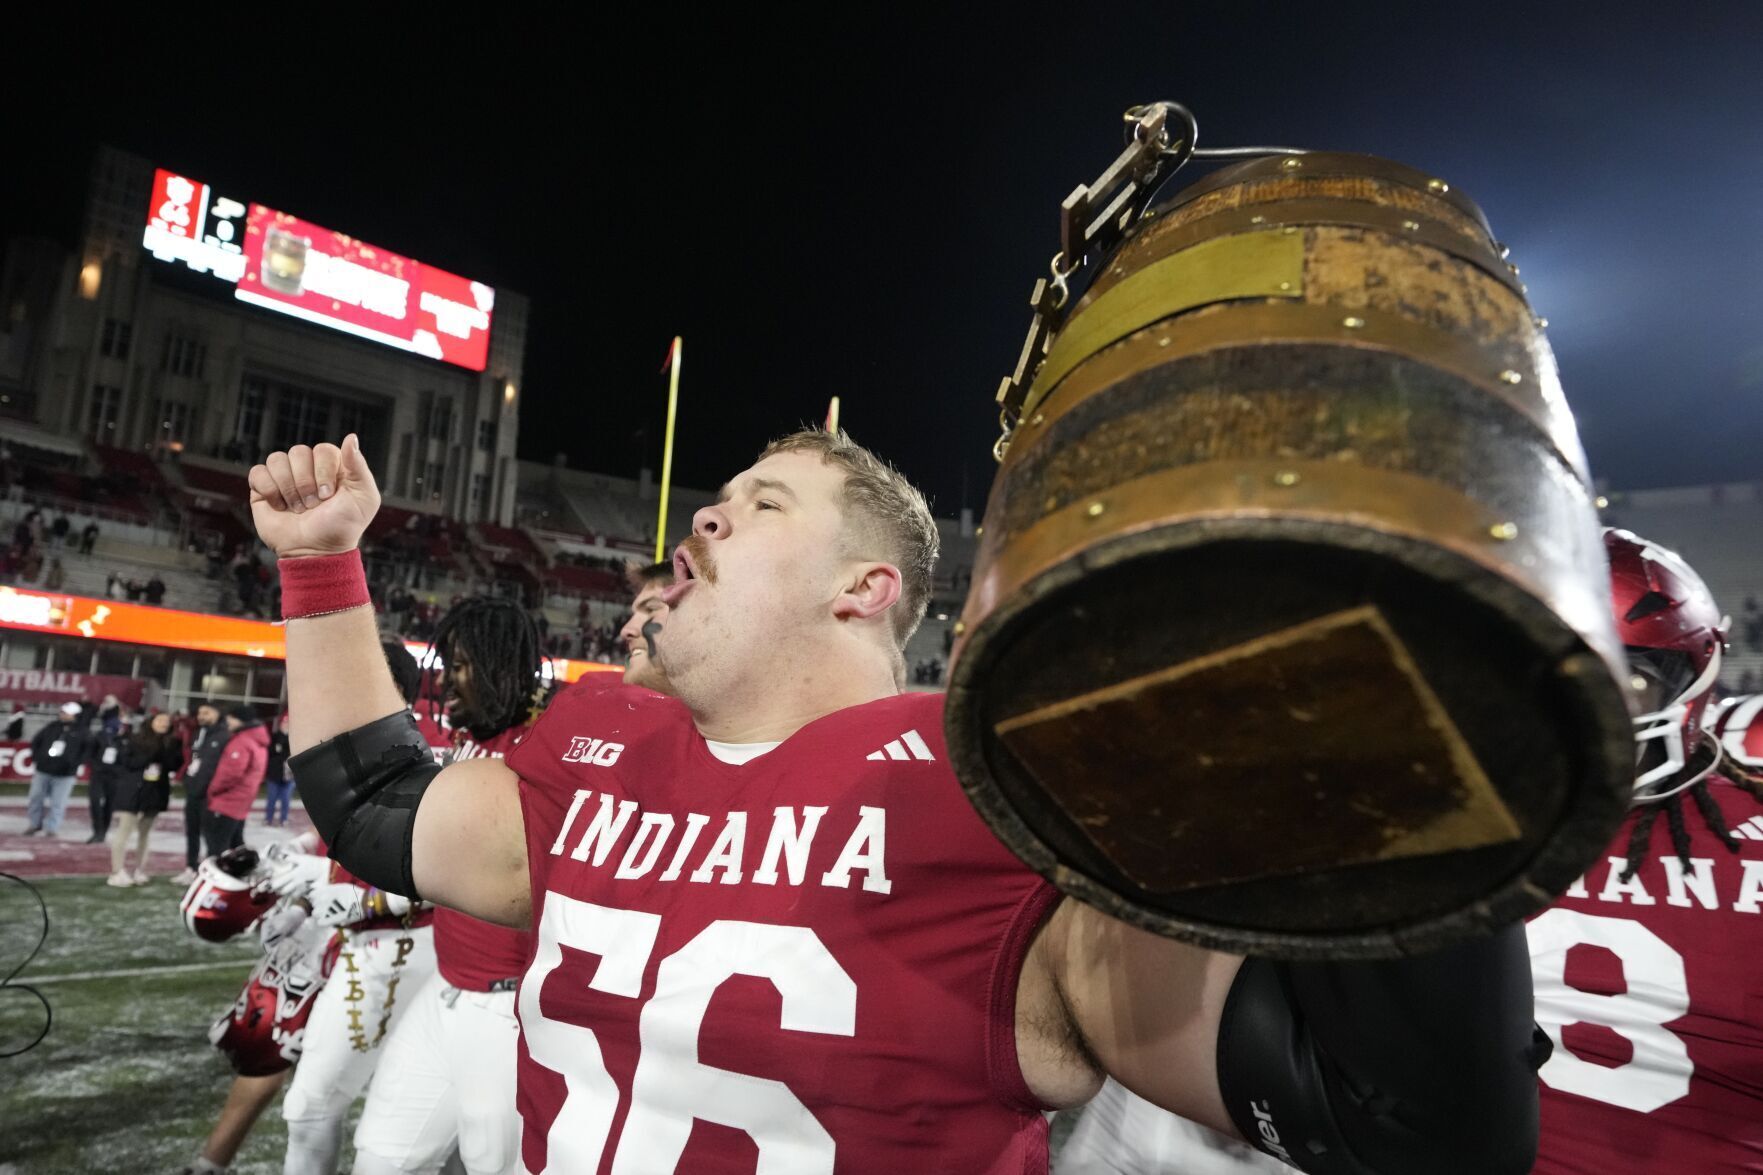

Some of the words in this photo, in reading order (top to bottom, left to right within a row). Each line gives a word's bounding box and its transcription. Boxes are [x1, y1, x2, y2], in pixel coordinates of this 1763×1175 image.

[550, 789, 892, 895] INDIANA
[517, 890, 857, 1175] 56
[1525, 907, 1694, 1114] 8
